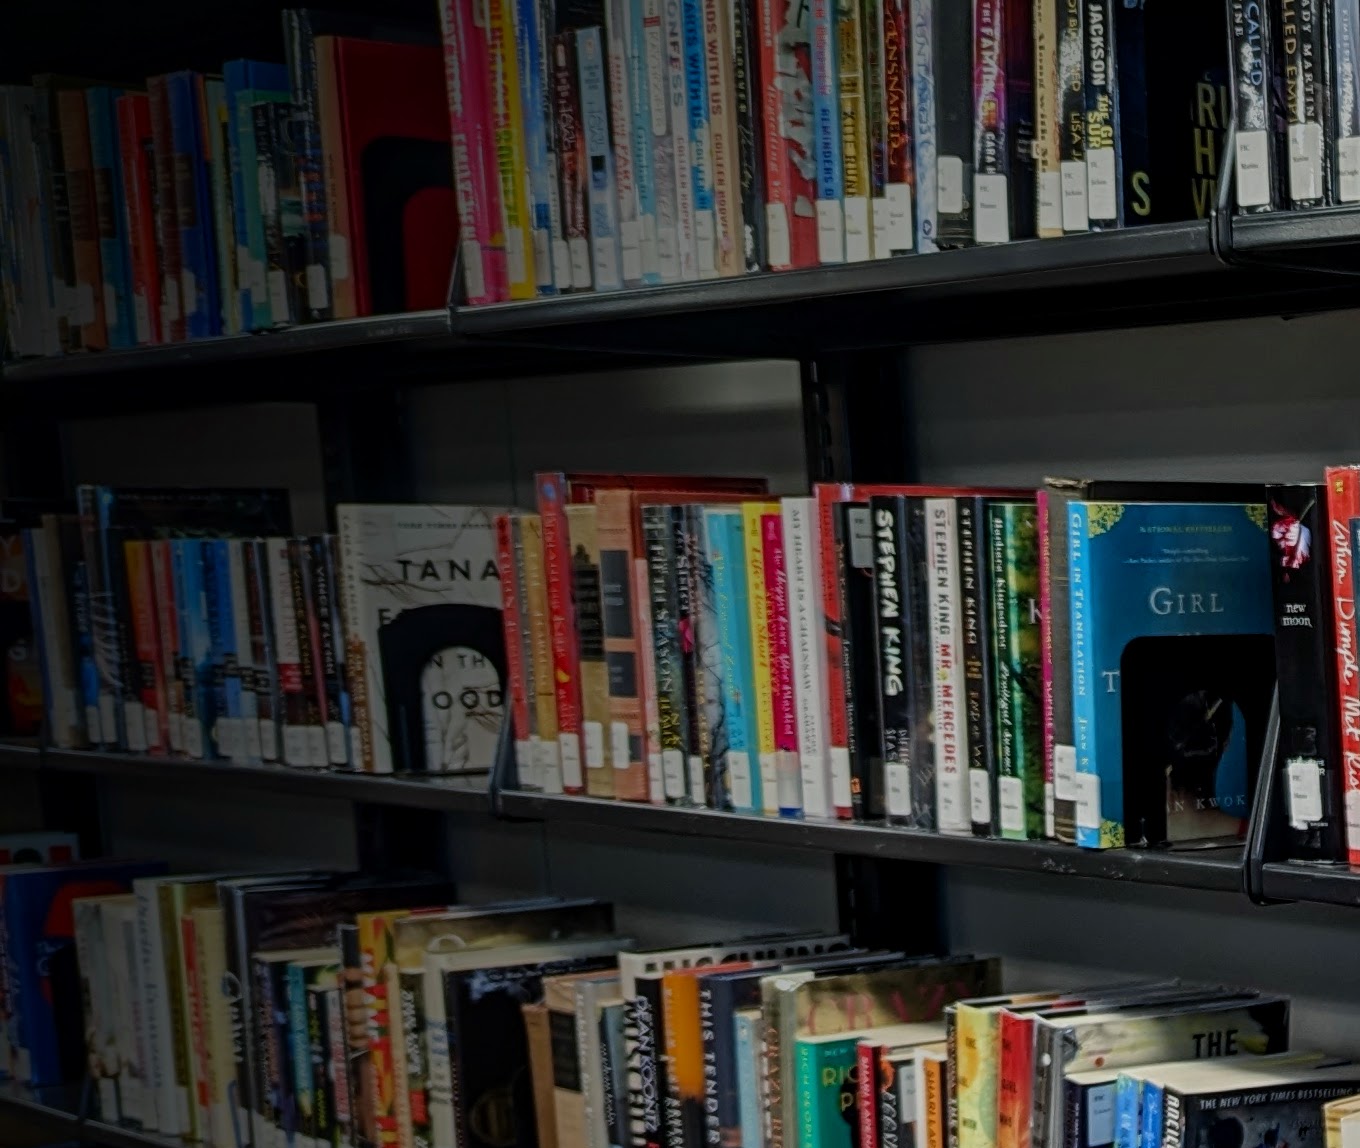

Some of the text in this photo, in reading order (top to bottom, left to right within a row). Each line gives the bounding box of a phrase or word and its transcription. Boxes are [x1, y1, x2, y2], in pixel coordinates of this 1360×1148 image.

[1090, 8, 1106, 86] JACKSON
[398, 559, 499, 583] TANA
[876, 507, 904, 697] STEPHEN KING
[1149, 587, 1225, 616] GIRL
[1192, 1029, 1239, 1058] THE
[1200, 1089, 1296, 1110] THE NEW YORK TIMES
